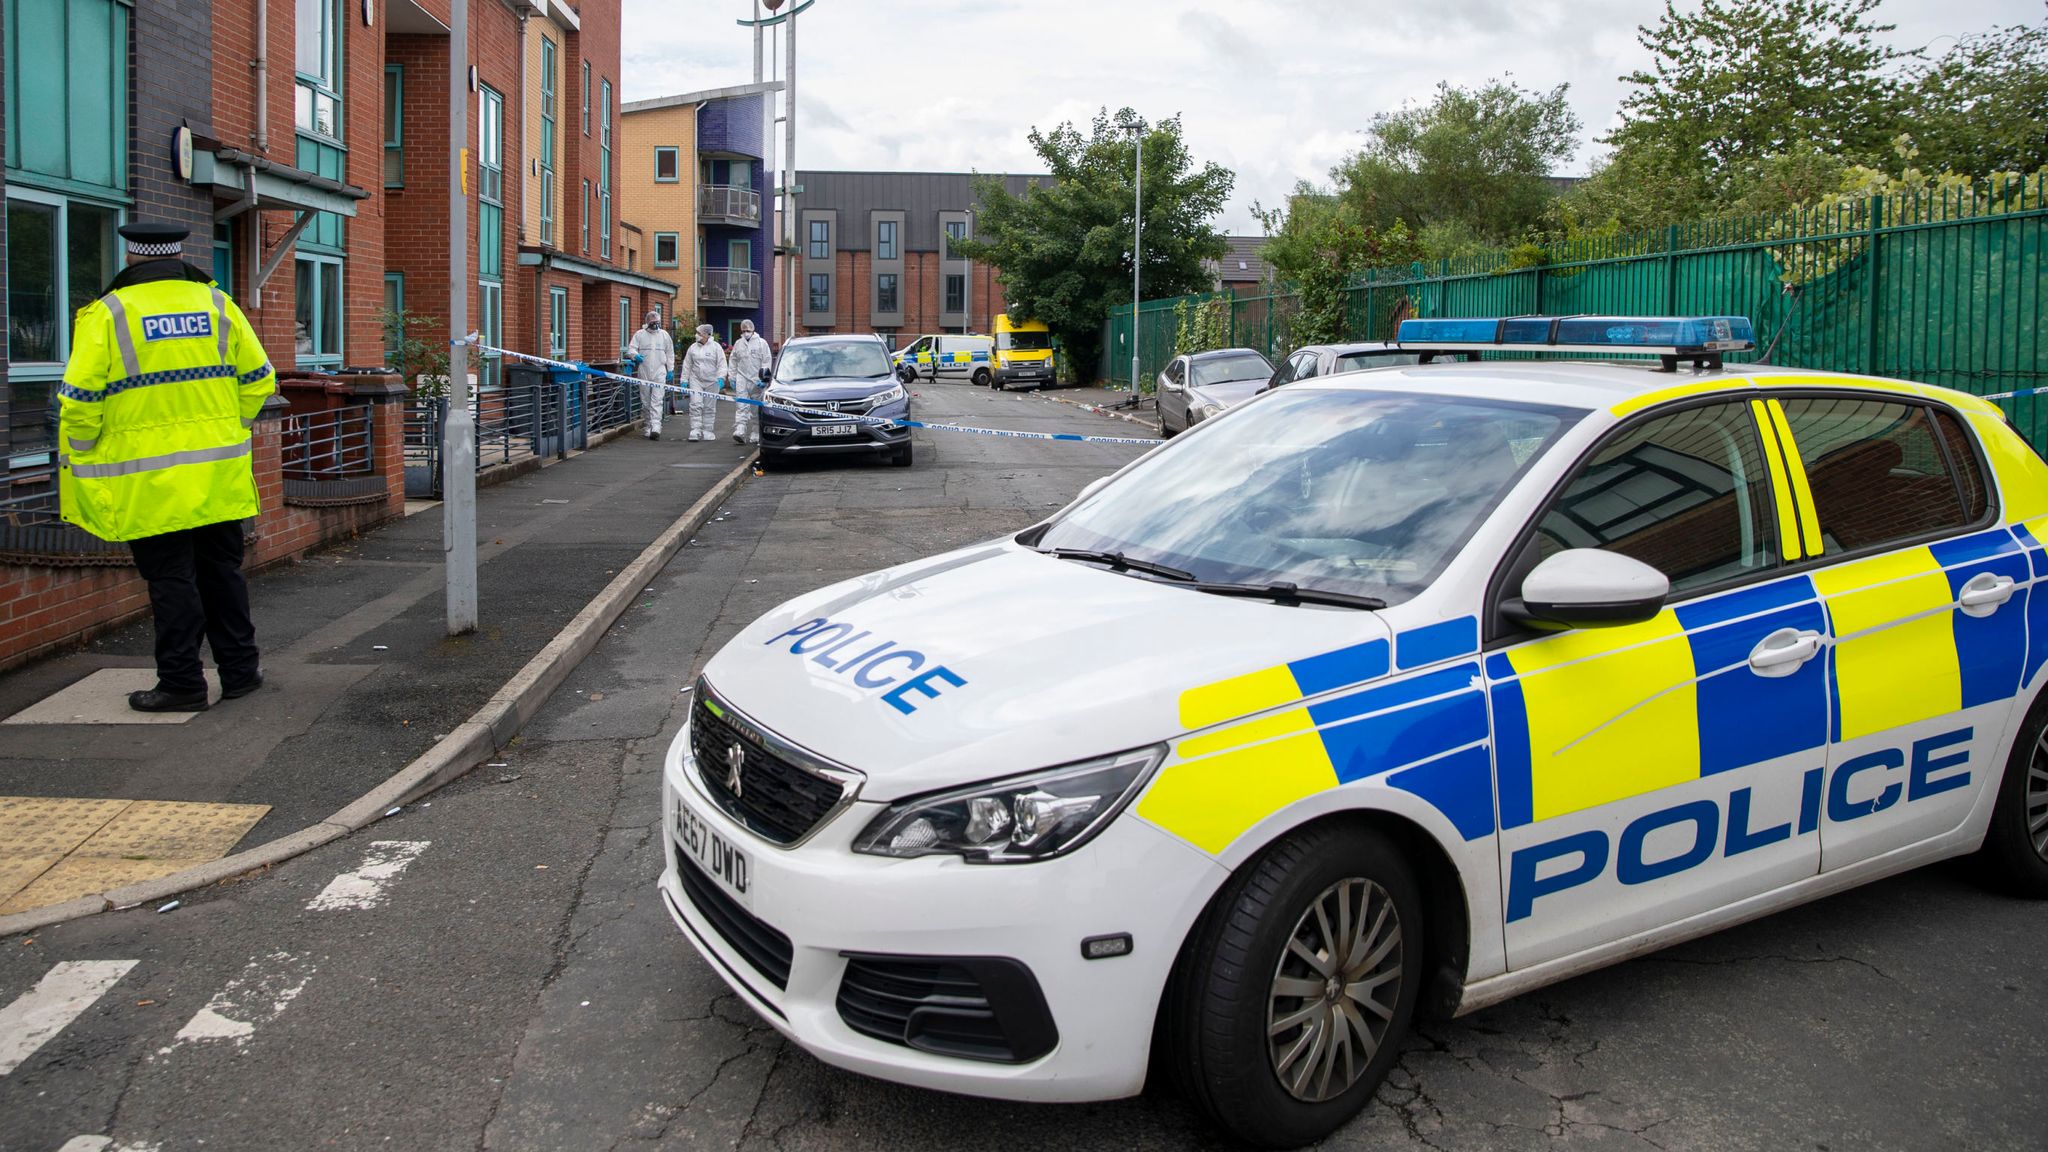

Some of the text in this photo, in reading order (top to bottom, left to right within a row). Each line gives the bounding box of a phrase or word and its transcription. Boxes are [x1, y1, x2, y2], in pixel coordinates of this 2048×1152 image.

[145, 315, 209, 337] POLICE
[816, 425, 852, 435] SR15 JJZ
[764, 617, 968, 716] POLICE
[676, 799, 747, 894] AE67 DWD
[1506, 726, 1974, 924] POLICE
